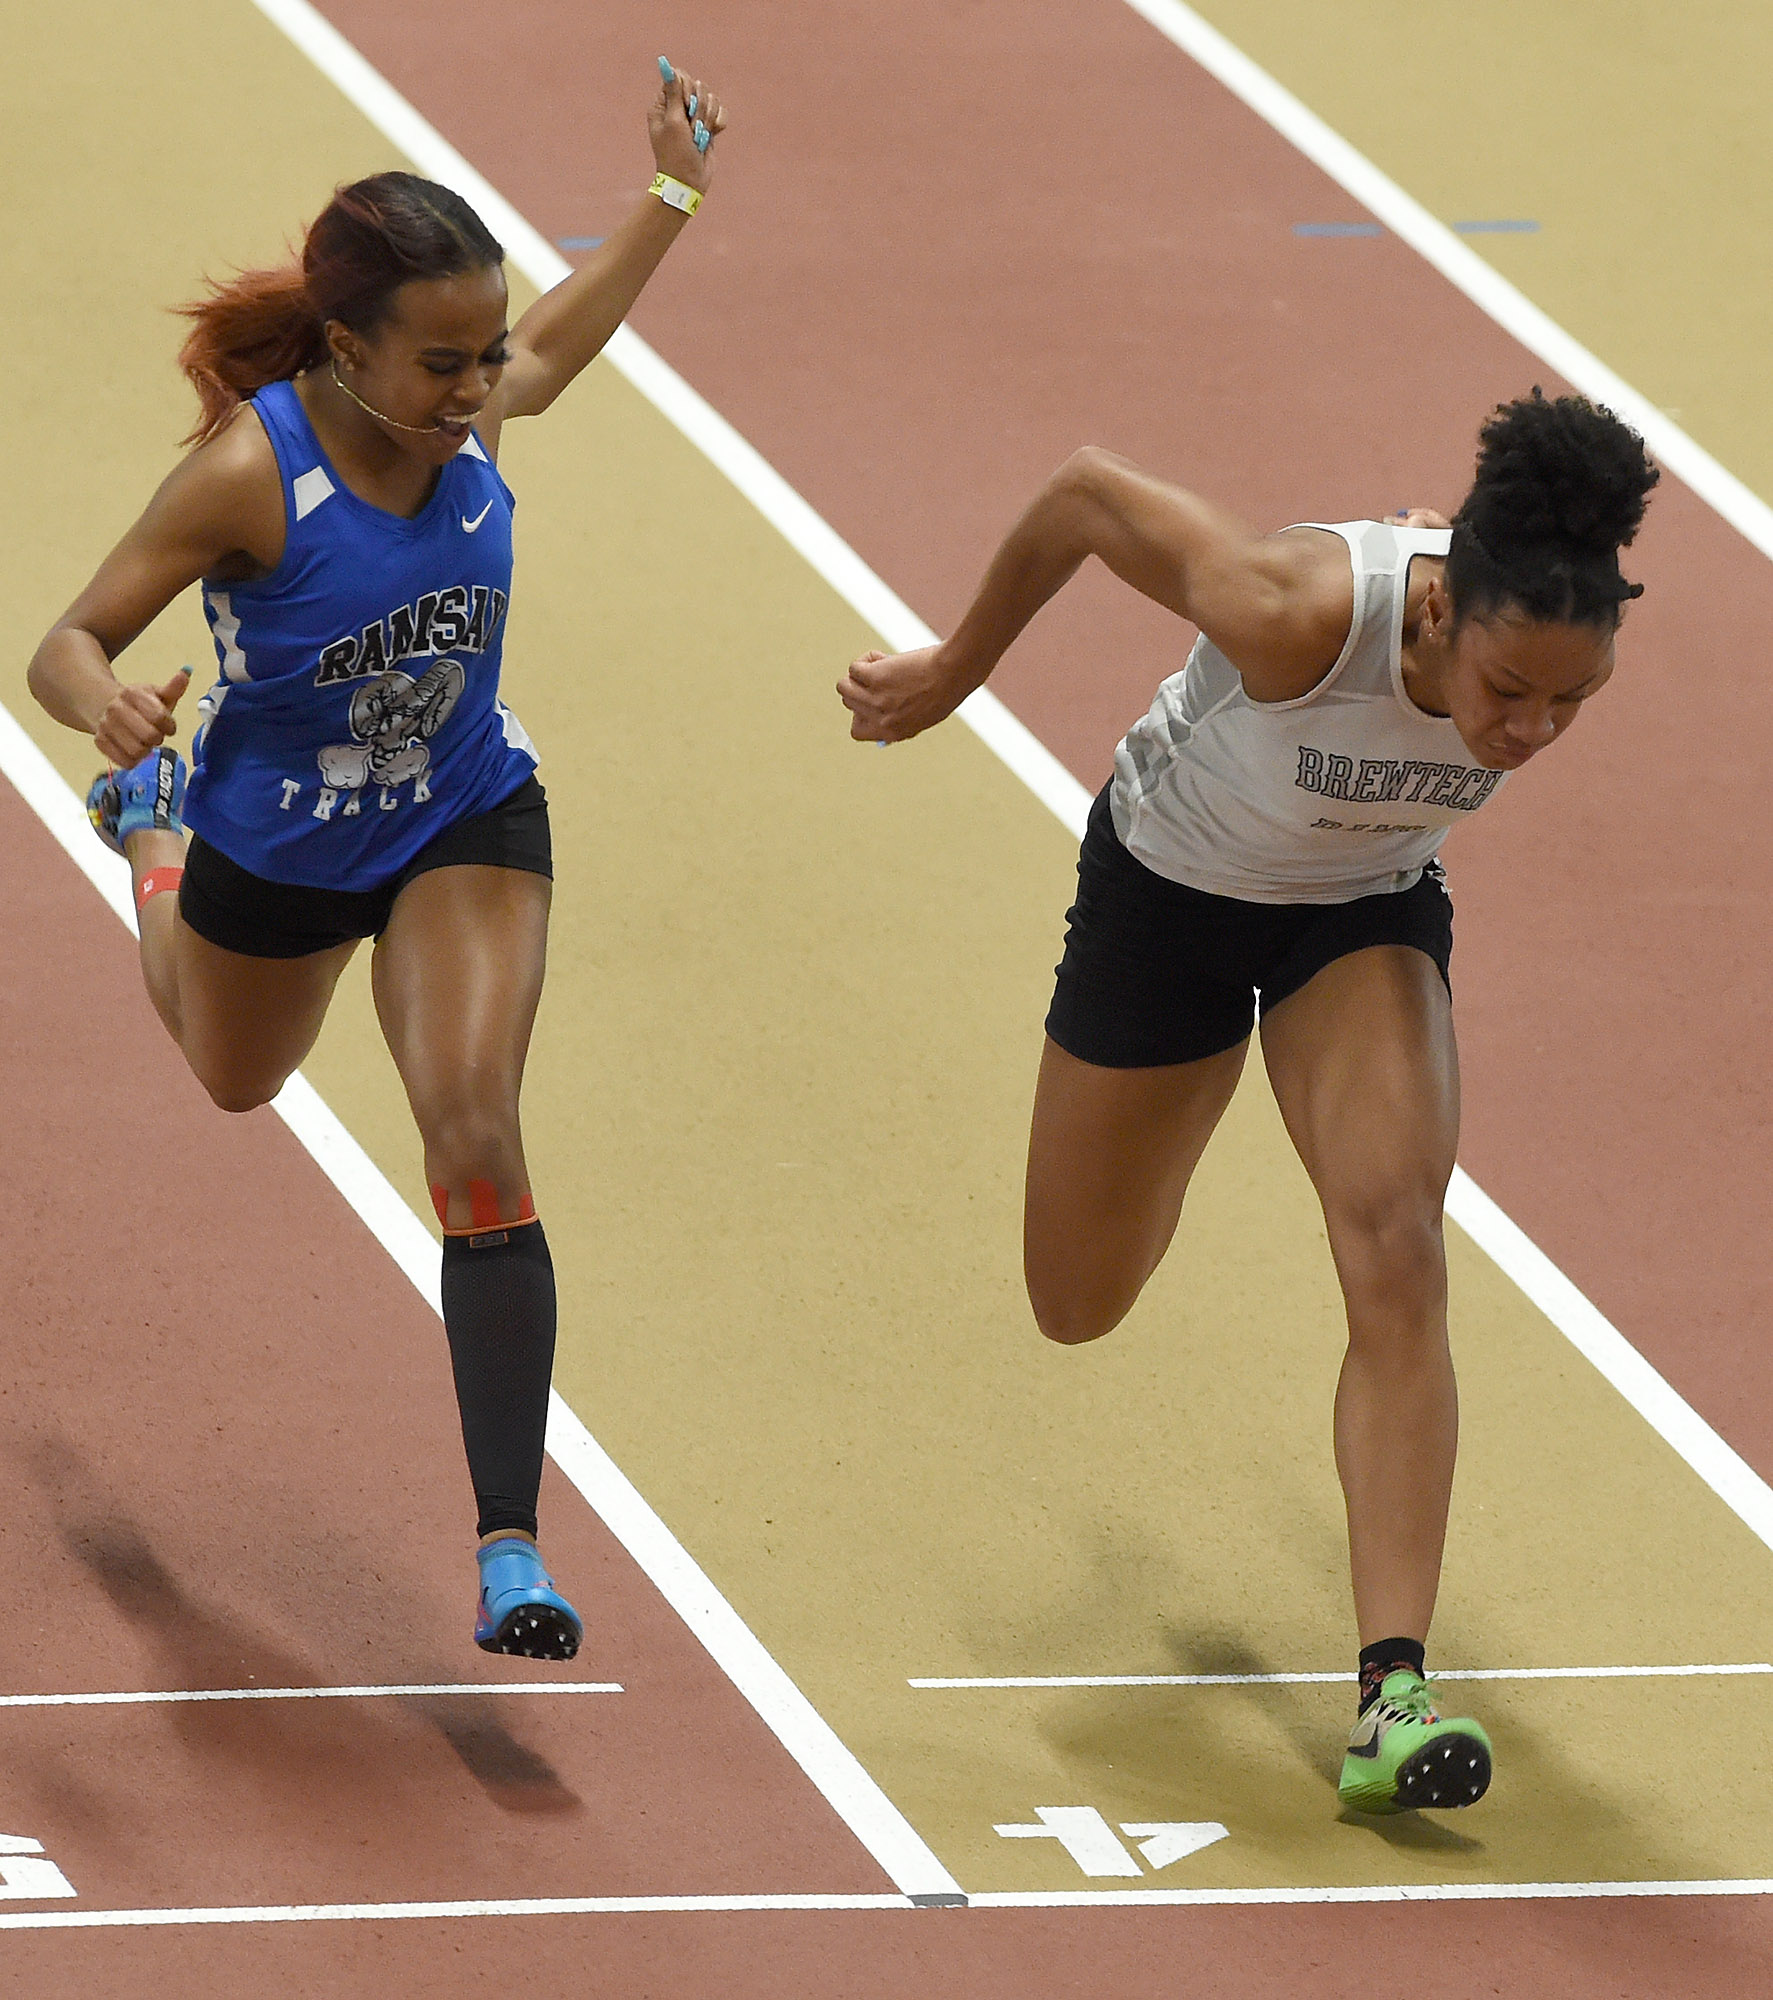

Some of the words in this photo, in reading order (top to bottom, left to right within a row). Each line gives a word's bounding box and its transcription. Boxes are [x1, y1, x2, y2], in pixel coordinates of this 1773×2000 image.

[313, 585, 508, 688] RAMSAY
[278, 769, 433, 822] TRACK
[1295, 745, 1504, 811] BREWTECH
[992, 1805, 1231, 1877] 4
